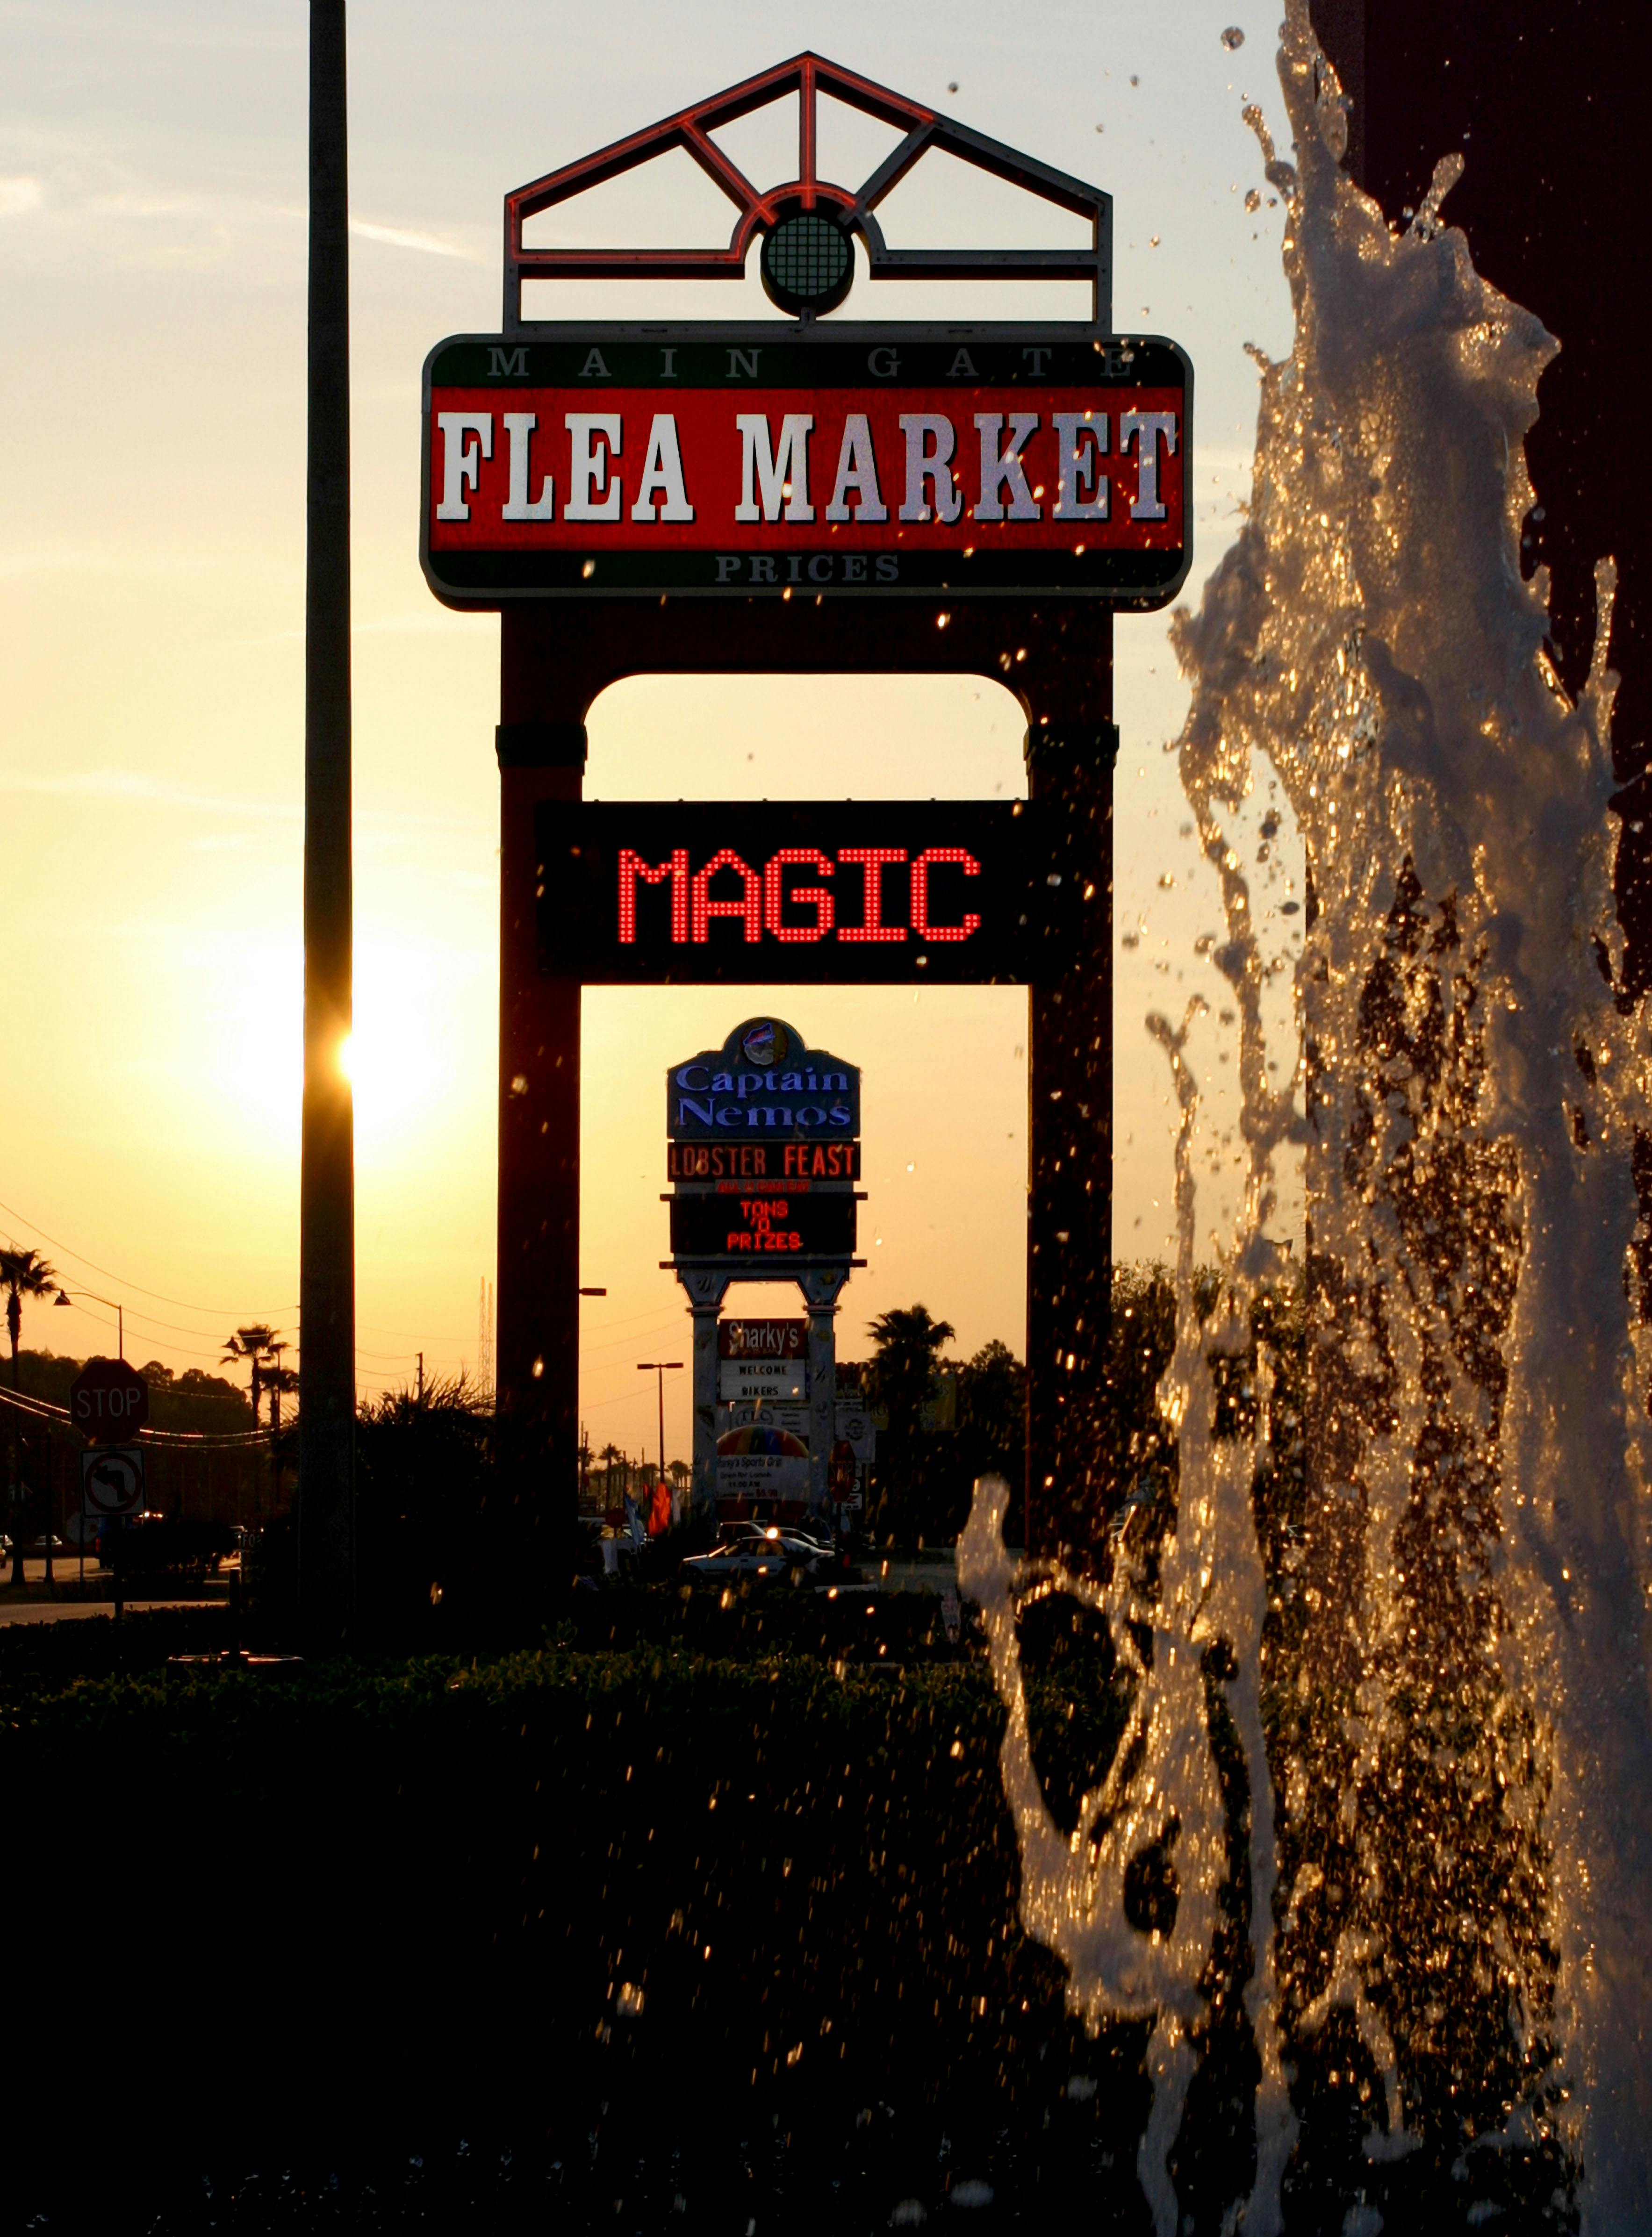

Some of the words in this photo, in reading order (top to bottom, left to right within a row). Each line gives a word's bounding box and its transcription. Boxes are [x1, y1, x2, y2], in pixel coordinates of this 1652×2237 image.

[487, 347, 761, 379] MAIN
[868, 347, 1133, 379] GATE
[436, 412, 694, 521] FLEA
[734, 412, 1177, 523] MARKET
[715, 555, 899, 582] PRICES
[618, 848, 981, 943] MAGIC
[676, 1065, 849, 1099] Captain
[678, 1097, 851, 1127] Nemos
[671, 1145, 767, 1176] LOBSTER
[783, 1144, 855, 1176] FEAST
[740, 1199, 790, 1219] TONS
[726, 1231, 801, 1251] PRIZES
[729, 1321, 799, 1355] Sharky's
[739, 1366, 786, 1375] WELCOME
[76, 1387, 141, 1419] STOP
[742, 1386, 778, 1396] BIKERS
